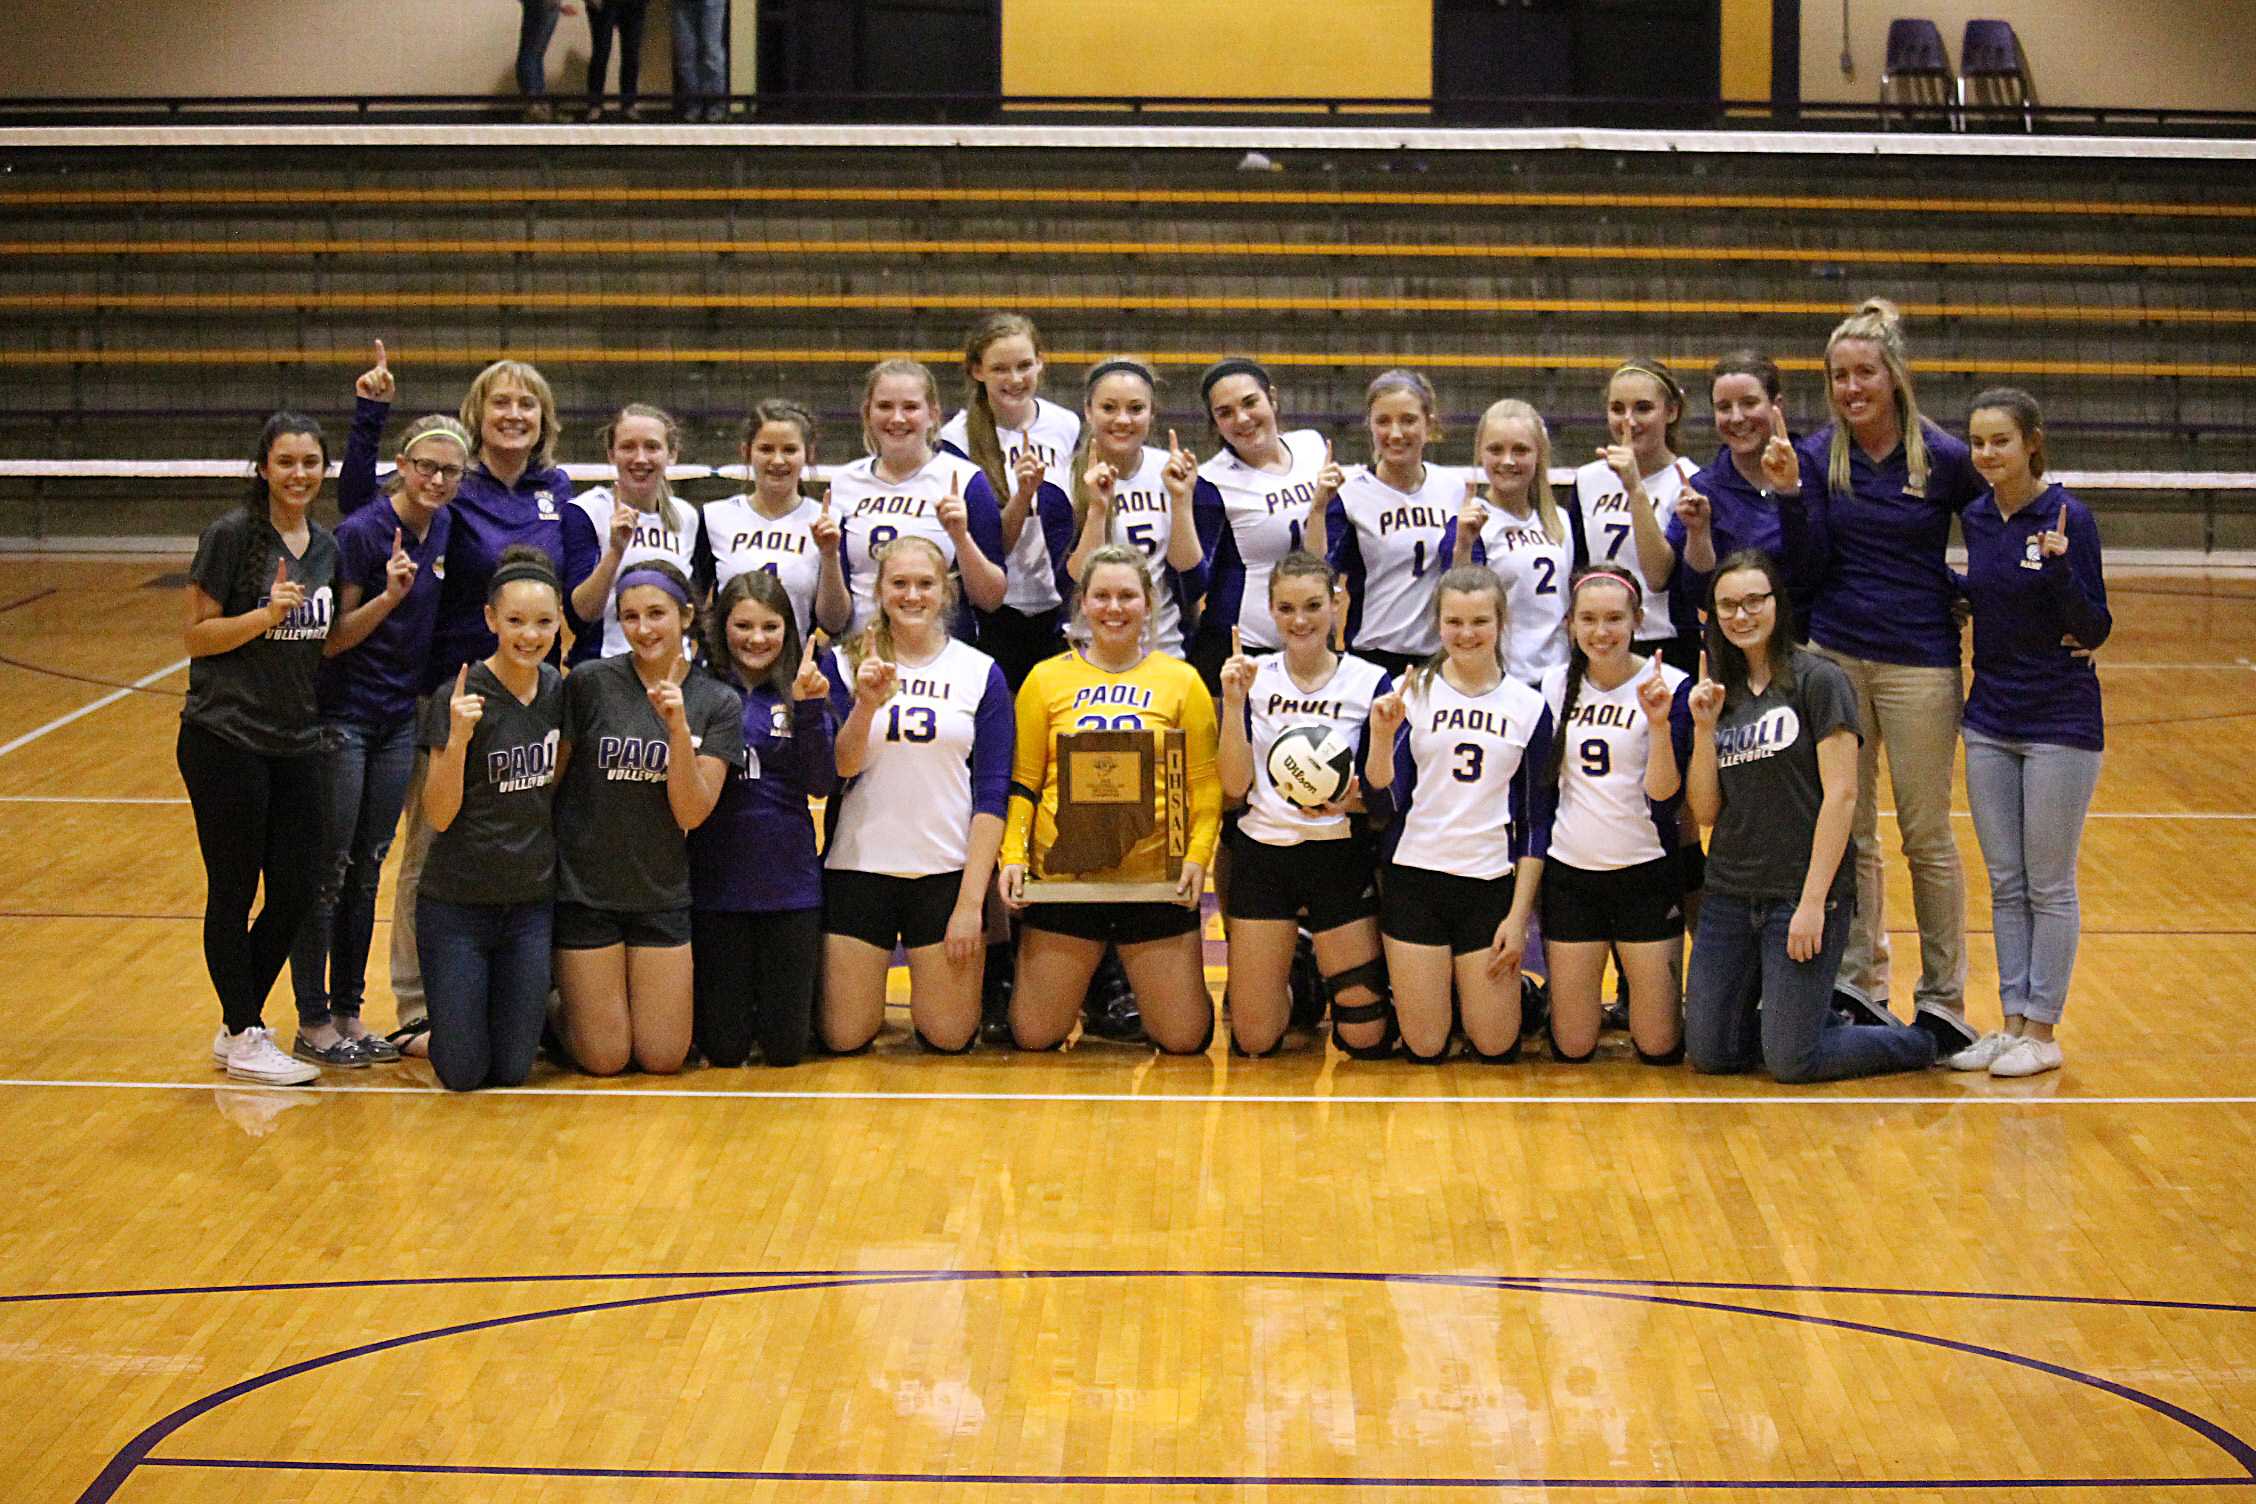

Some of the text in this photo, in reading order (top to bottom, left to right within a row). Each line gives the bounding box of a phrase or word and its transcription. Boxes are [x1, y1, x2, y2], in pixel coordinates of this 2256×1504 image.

[853, 495, 927, 518] PAOLI
[1115, 490, 1167, 516] AOLI
[1265, 481, 1316, 515] PAO
[1379, 506, 1448, 536] PAOLI
[632, 526, 680, 555] AOLI
[731, 529, 807, 556] PAOLI
[1126, 523, 1157, 559] 5
[1603, 523, 1631, 561] 7
[1412, 540, 1425, 578] 1
[1533, 556, 1557, 596] 2
[899, 678, 951, 700] AOLI
[1073, 684, 1152, 709] PAOLI
[885, 704, 937, 744] 13
[1431, 708, 1508, 738] PAOLI
[1714, 716, 1784, 757] AOLI
[598, 736, 669, 773] PAO
[1452, 742, 1485, 784] 3
[1580, 738, 1611, 777] 9
[1284, 754, 1318, 795] Wilson
